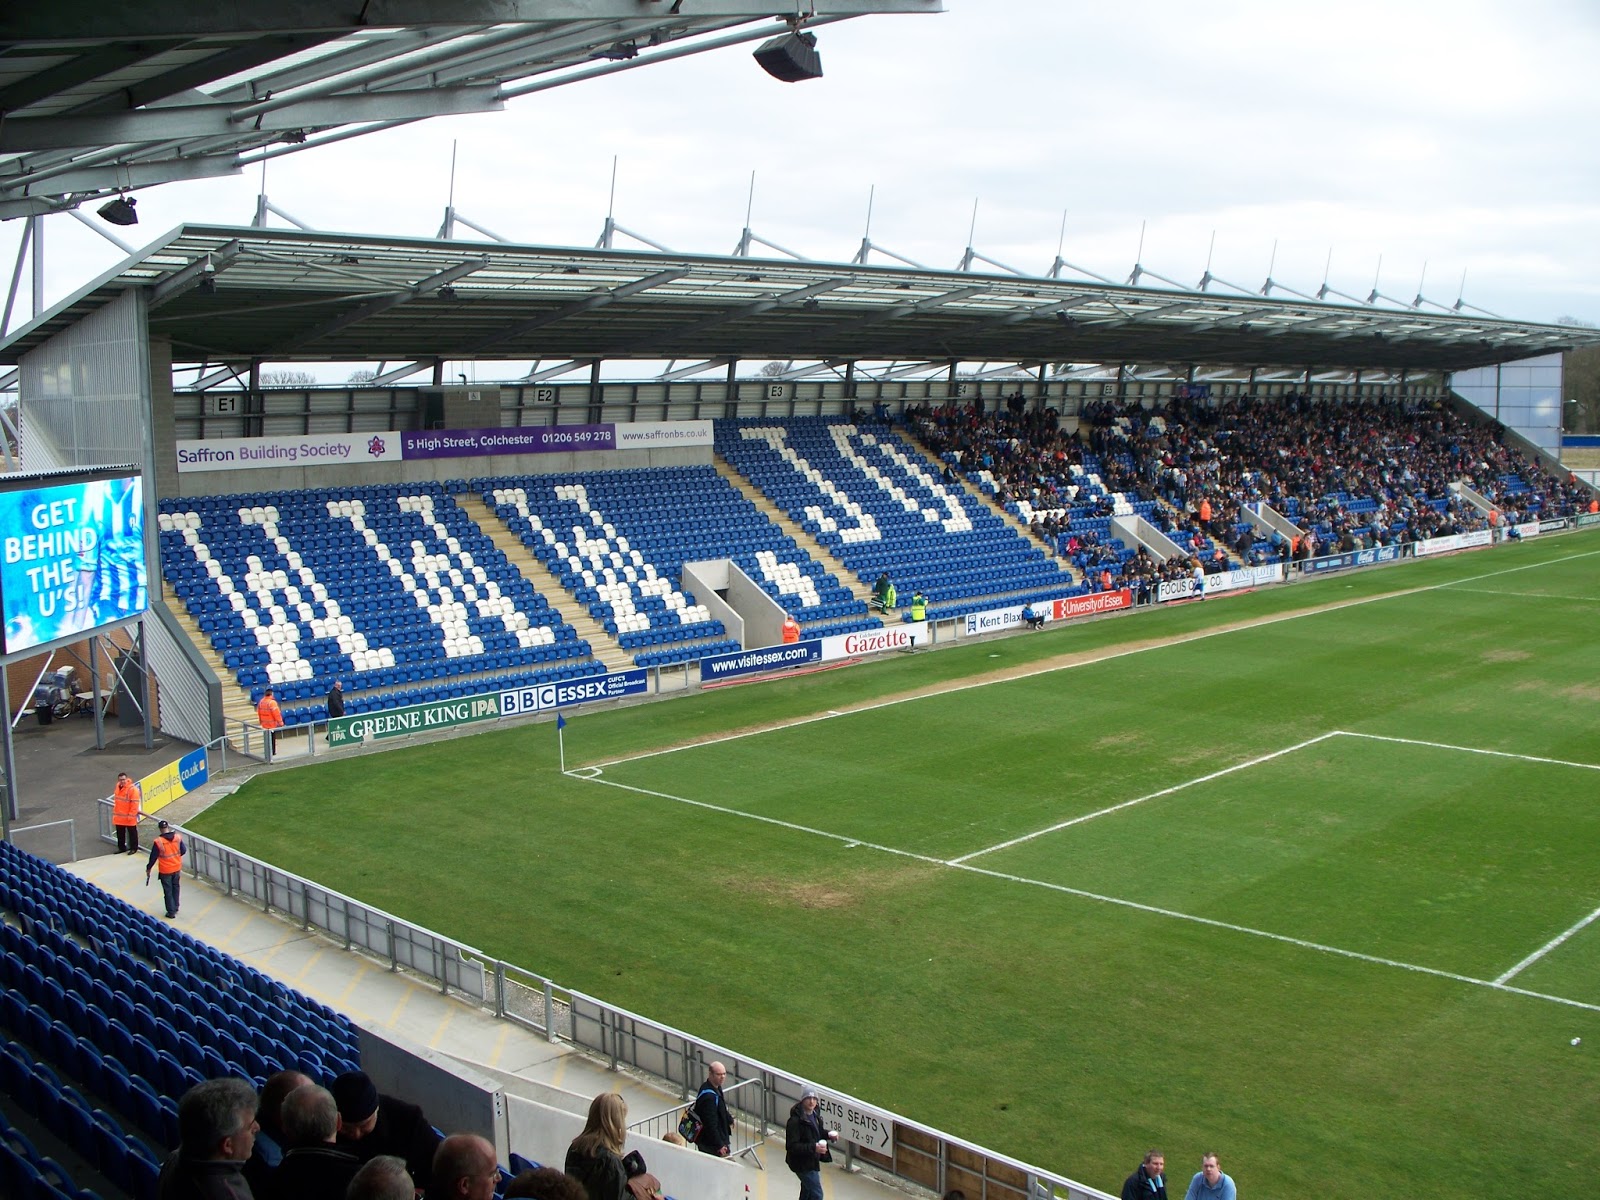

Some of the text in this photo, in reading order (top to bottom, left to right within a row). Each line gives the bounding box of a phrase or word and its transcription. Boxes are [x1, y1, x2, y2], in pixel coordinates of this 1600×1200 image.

[537, 390, 552, 401] E2
[771, 386, 783, 396] E3
[219, 398, 235, 411] E1
[407, 434, 534, 451] 5 High Street, Colchester
[541, 431, 611, 443] 01206 549 278
[622, 429, 708, 441] www.saffronbs.co.uk
[179, 442, 352, 463] Saffron Building Society
[31, 498, 78, 530] GET
[5, 527, 98, 564] BEHIND
[26, 558, 76, 593] THE
[1161, 581, 1187, 596] FOCUS
[38, 584, 86, 617] U'S!
[1066, 595, 1123, 614] University of Essex
[980, 614, 1001, 628] Kent
[845, 629, 908, 654] Gazette
[711, 647, 808, 673] www.visitessex.com
[607, 688, 625, 696] Partner
[624, 679, 646, 688] Broadcast
[503, 681, 608, 712] BBC ESSEX
[349, 698, 499, 738] GREENE KING IPA
[332, 732, 346, 742] IPA
[830, 1120, 842, 1132] 138
[847, 1109, 878, 1132] SEATS
[852, 1128, 860, 1140] 72
[866, 1134, 874, 1145] 97
